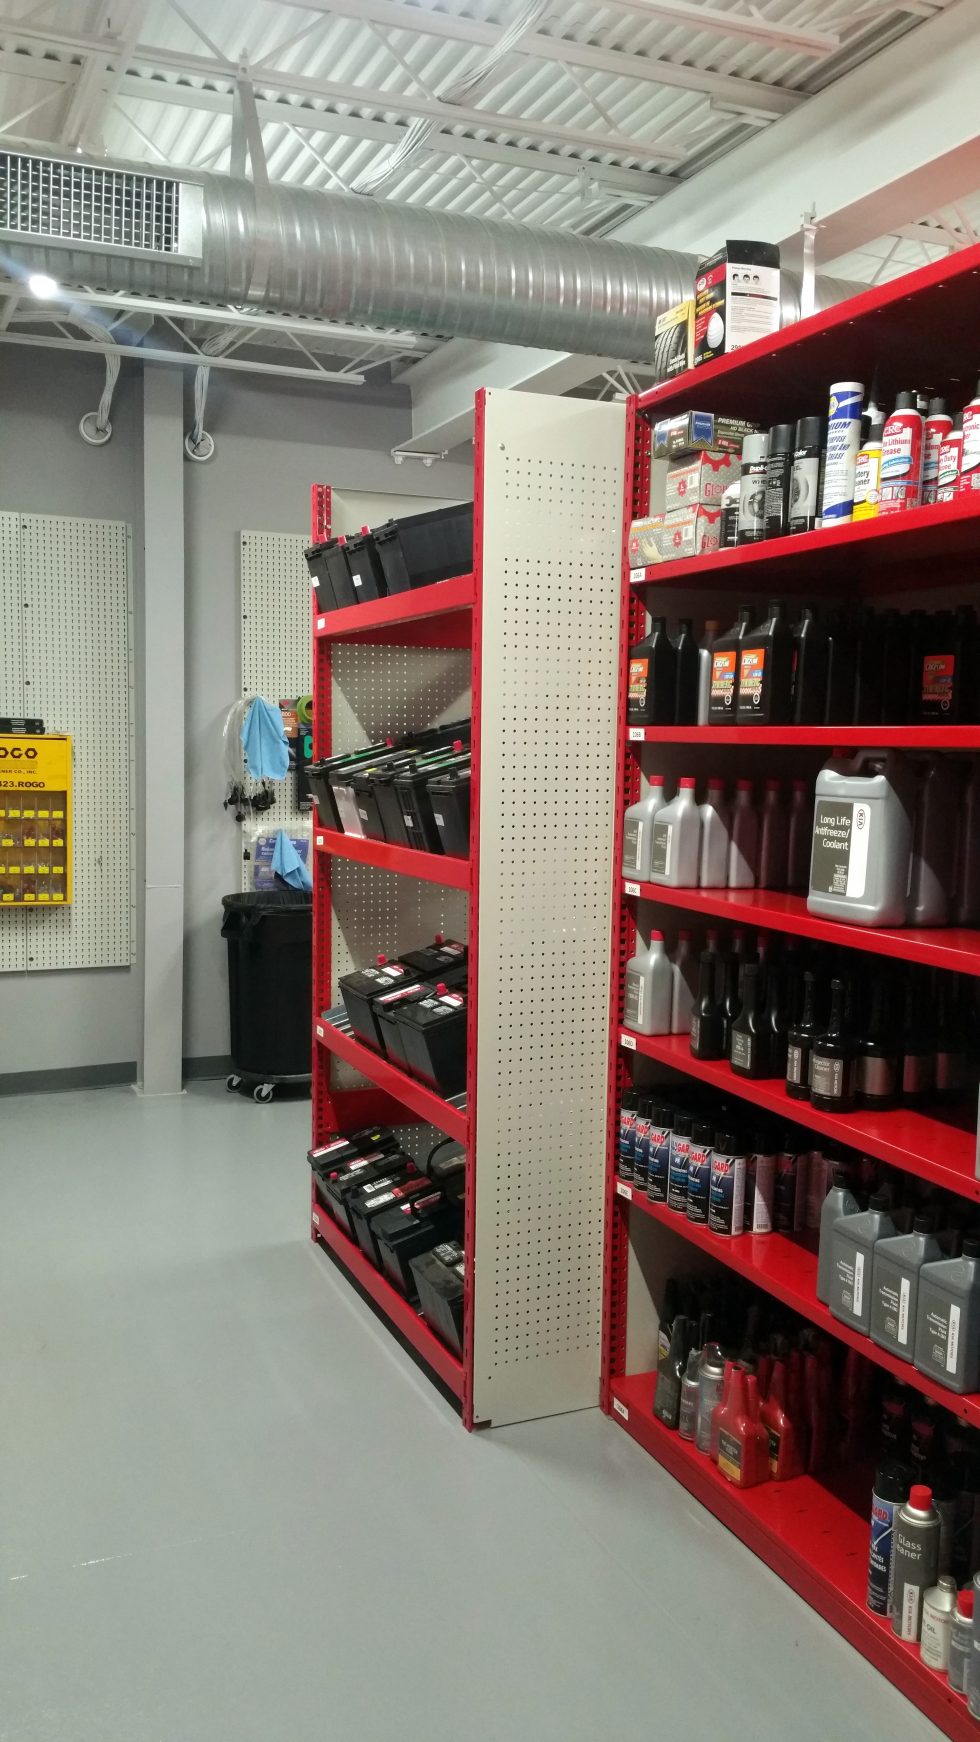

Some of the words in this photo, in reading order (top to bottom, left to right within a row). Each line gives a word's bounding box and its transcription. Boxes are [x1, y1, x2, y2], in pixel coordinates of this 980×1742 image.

[718, 417, 746, 427] PREMIUM
[888, 437, 911, 447] Lithium
[820, 814, 836, 826] Long
[836, 816, 851, 826] Life
[815, 825, 850, 838] Antifreeze/
[822, 838, 849, 850] Coolant
[677, 1143, 690, 1154] GAR
[713, 1160, 730, 1173] GARD
[898, 1533, 922, 1551] Glass
